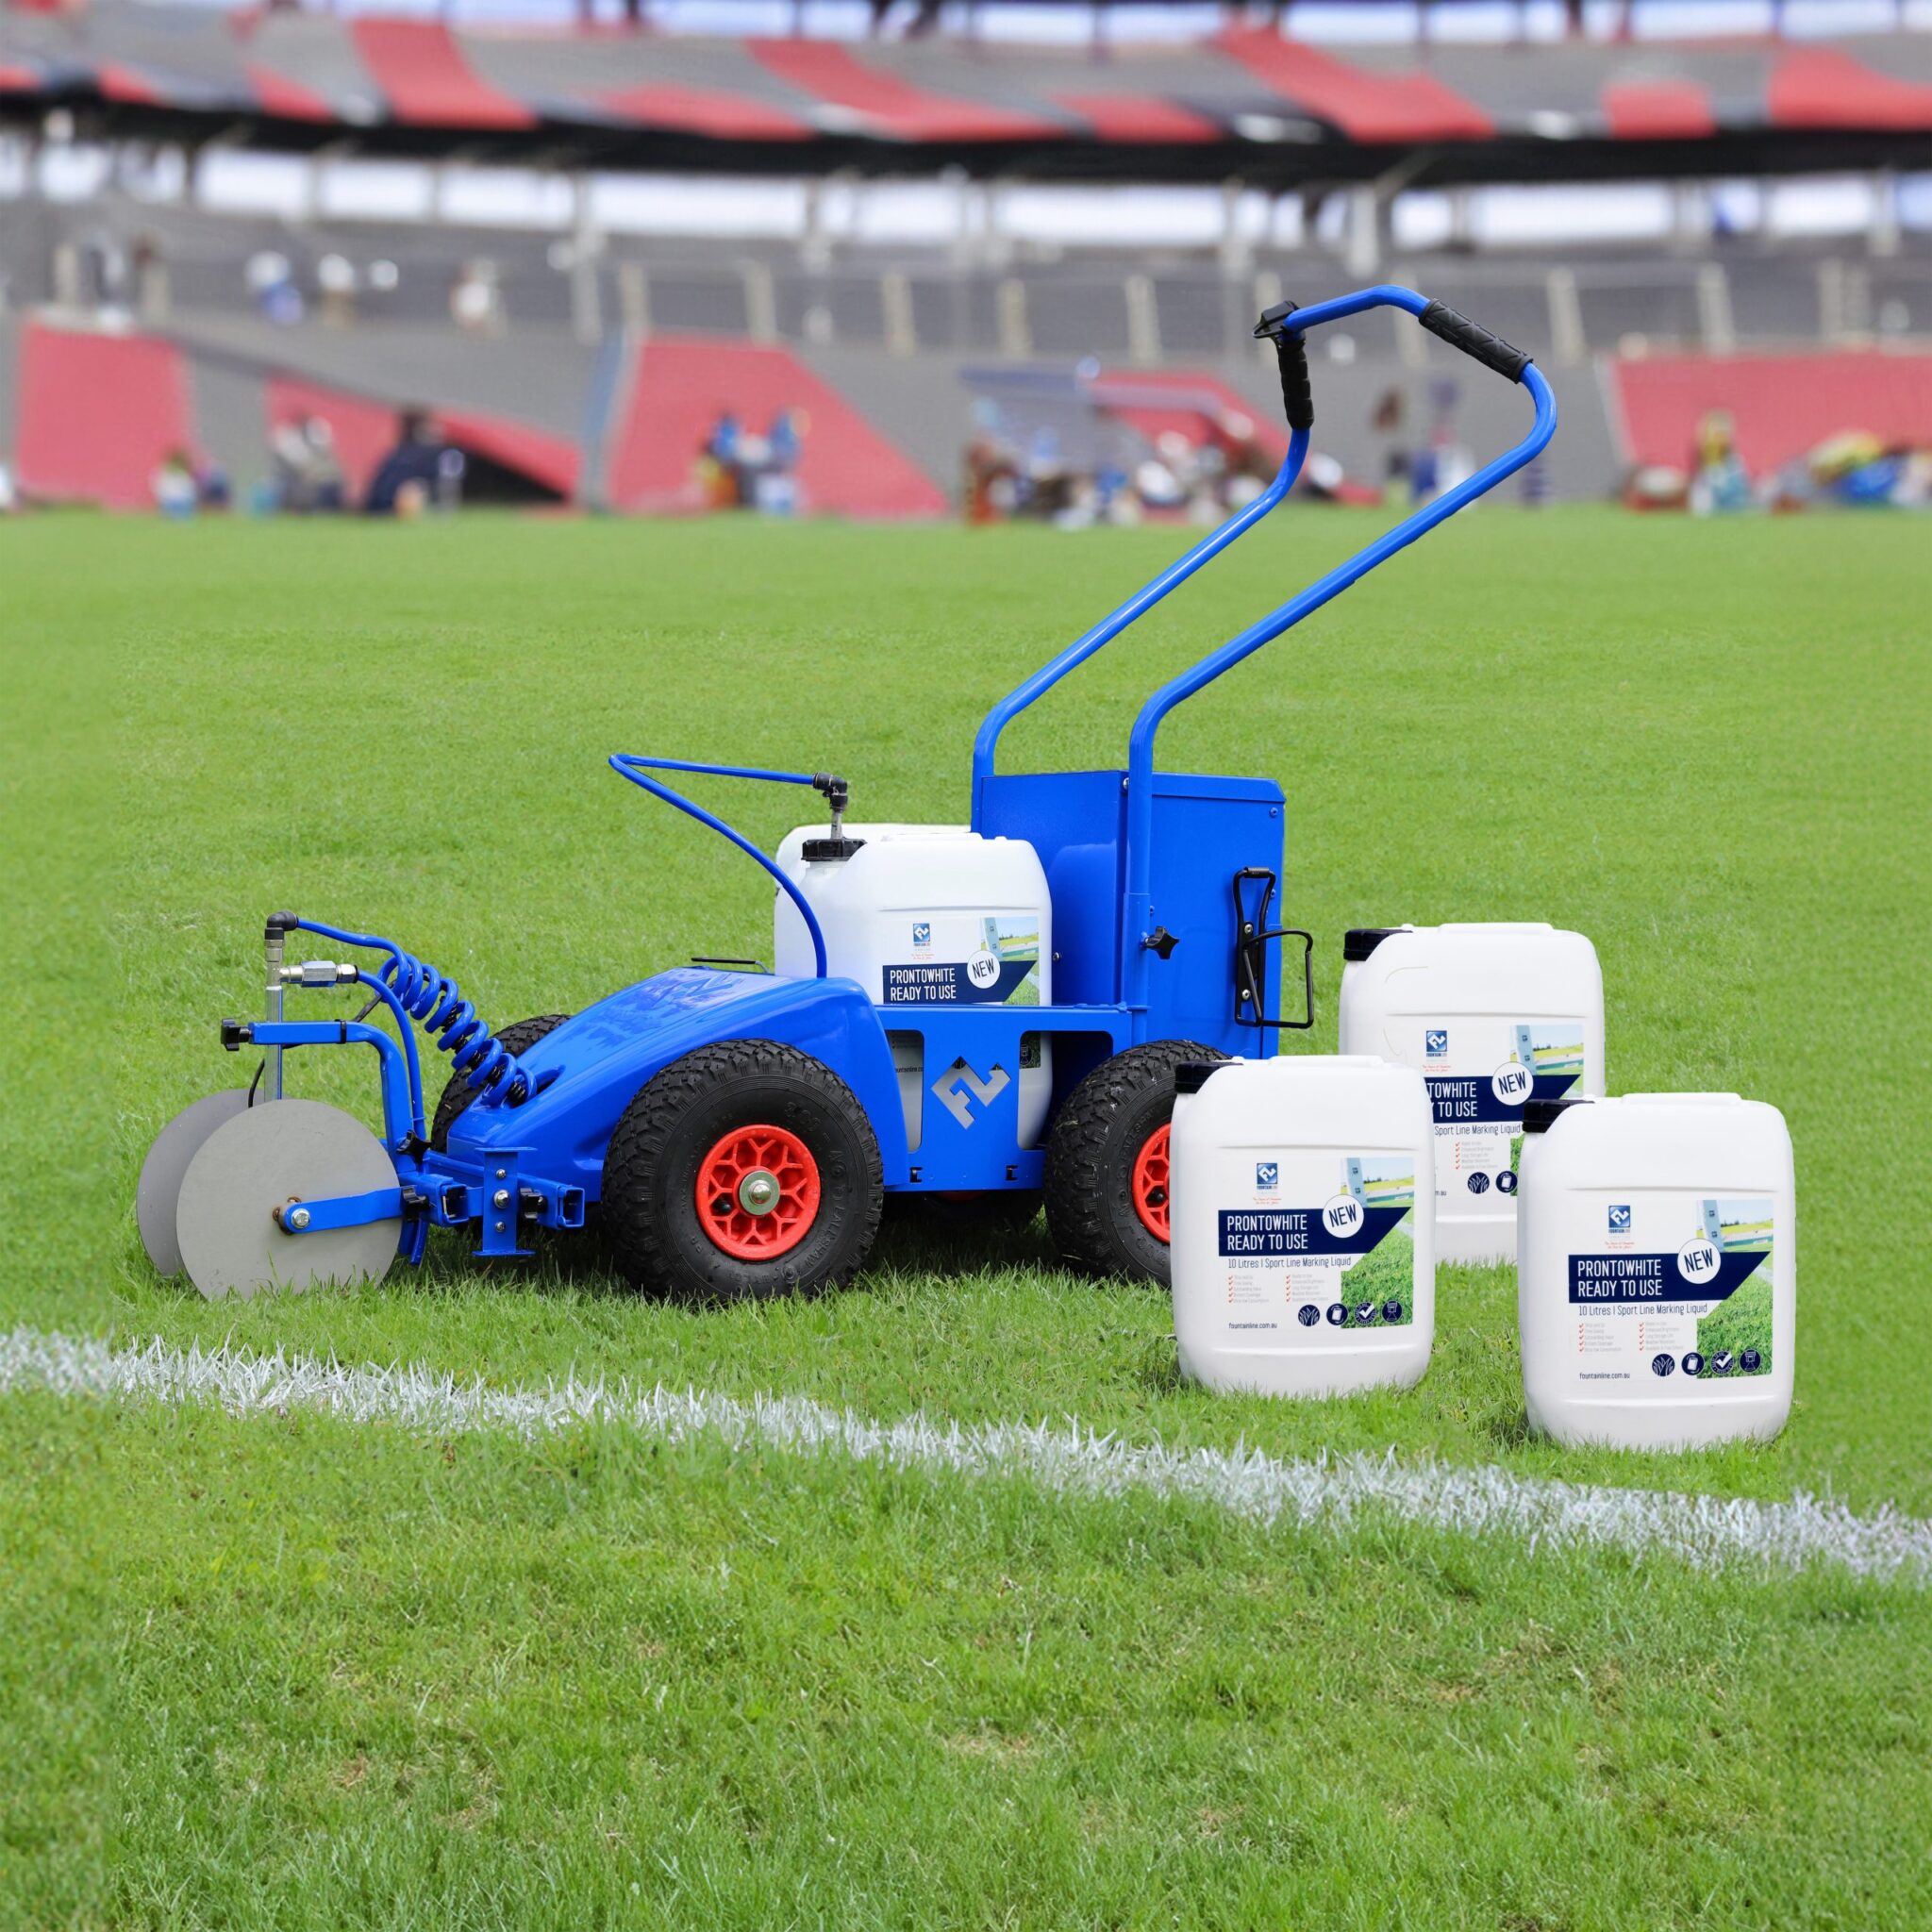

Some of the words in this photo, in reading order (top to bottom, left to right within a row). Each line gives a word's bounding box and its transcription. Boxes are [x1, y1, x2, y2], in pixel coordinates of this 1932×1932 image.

[890, 968, 956, 984] PRONTOWHITE
[973, 958, 995, 979] NEW
[891, 986, 921, 1001] READY
[924, 986, 937, 1000] TO
[939, 985, 957, 1000] USE
[1426, 1081, 1477, 1098] TOWHITE
[1498, 1072, 1527, 1095] NEW
[1437, 1101, 1453, 1118] TO
[1456, 1101, 1478, 1117] USE
[1434, 1125, 1454, 1137] Sport
[1457, 1125, 1471, 1135] Line
[1473, 1124, 1499, 1136] Marking
[1501, 1124, 1521, 1135] Liquid
[1227, 1214, 1307, 1232] PRONTOWHITE
[1328, 1204, 1357, 1228] NEW
[1227, 1235, 1265, 1251] READY
[1268, 1234, 1283, 1250] TO
[1286, 1233, 1308, 1250] USE
[1228, 1258, 1237, 1269] 10
[1238, 1258, 1259, 1269] Litres
[1265, 1257, 1284, 1270] Sport
[1286, 1257, 1301, 1268] Line
[1302, 1257, 1329, 1269] Marking
[1331, 1256, 1352, 1268] Liquid
[1577, 1259, 1662, 1277] PRONTOWHITE
[1684, 1248, 1713, 1274] NEW
[1577, 1280, 1617, 1297] READY
[1621, 1280, 1637, 1297] TO
[1640, 1279, 1663, 1296] USE
[1579, 1306, 1588, 1316] 10
[1589, 1306, 1611, 1316] Litres
[1617, 1305, 1638, 1317] Sport
[1640, 1305, 1655, 1315] Line
[1657, 1304, 1685, 1316] Marking
[1687, 1303, 1707, 1315] Liquid
[1579, 1372, 1631, 1380] fountainline.com.au
